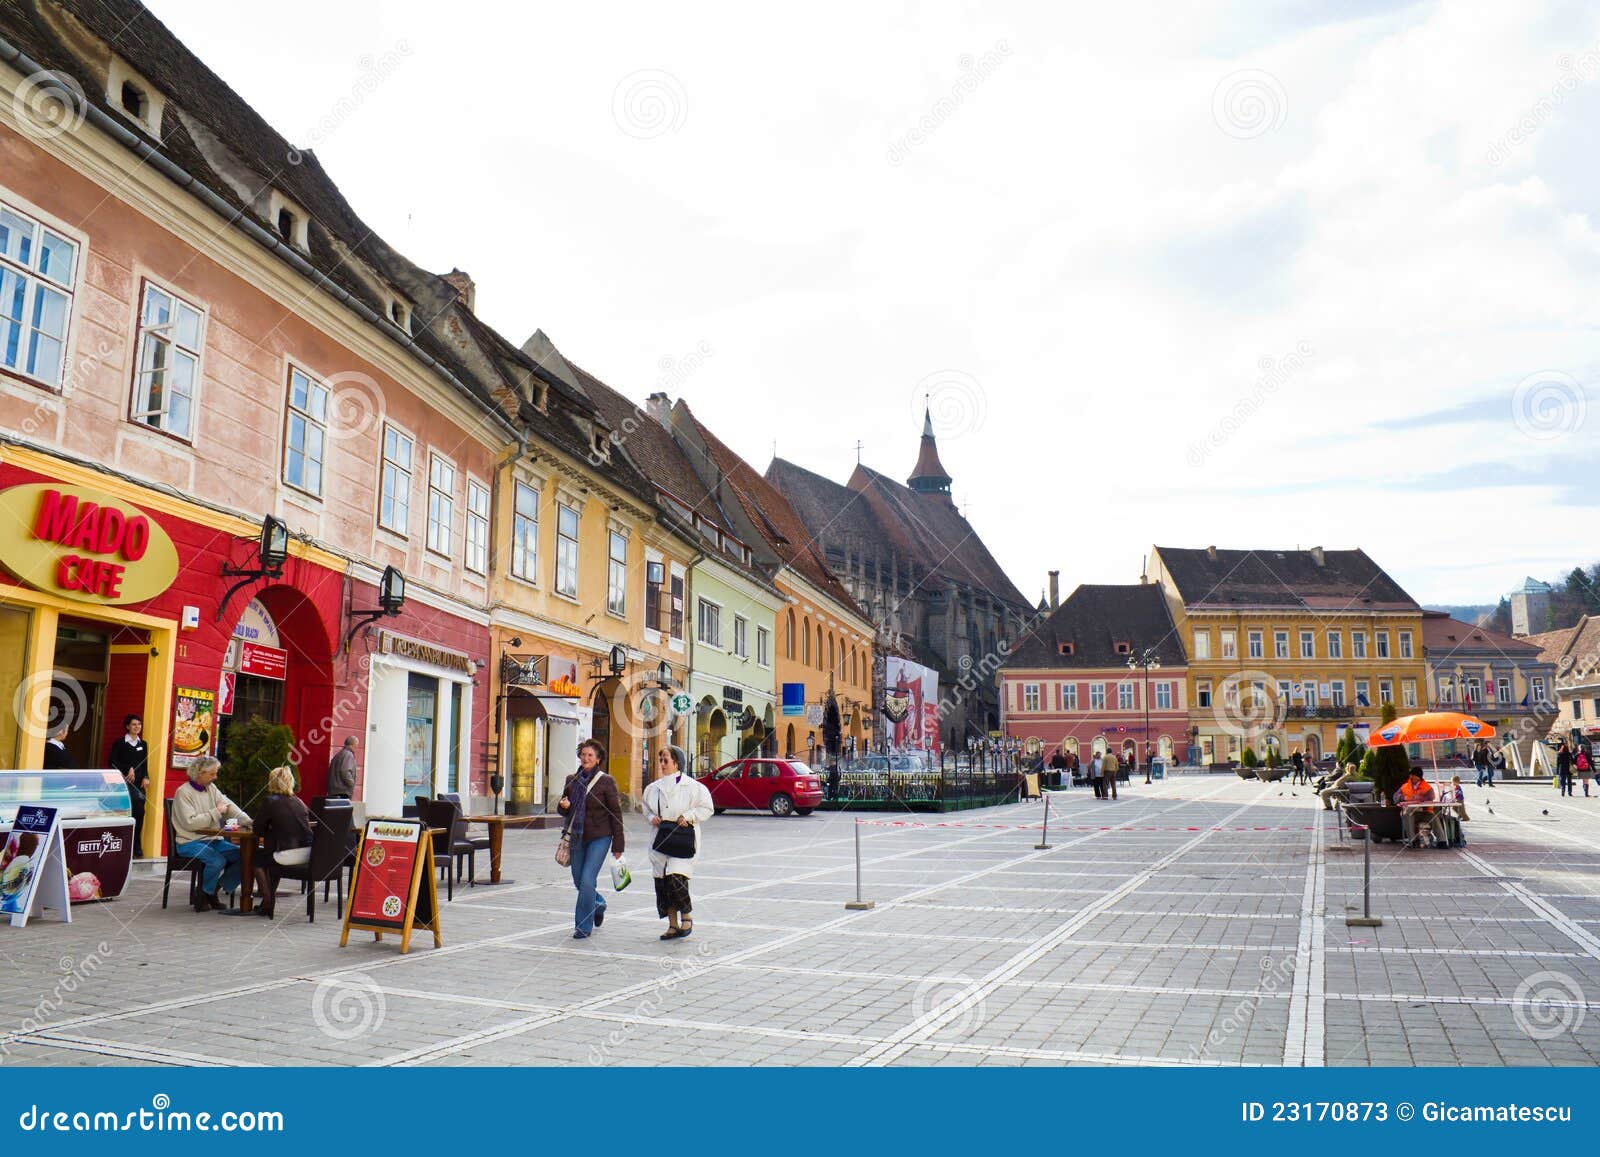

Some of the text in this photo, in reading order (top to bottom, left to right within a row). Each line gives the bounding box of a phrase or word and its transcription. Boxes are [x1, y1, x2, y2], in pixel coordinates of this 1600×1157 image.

[32, 489, 149, 562] MADO
[56, 554, 126, 599] CAFE
[178, 644, 188, 658] 11
[80, 841, 121, 852] BETTY ICE
